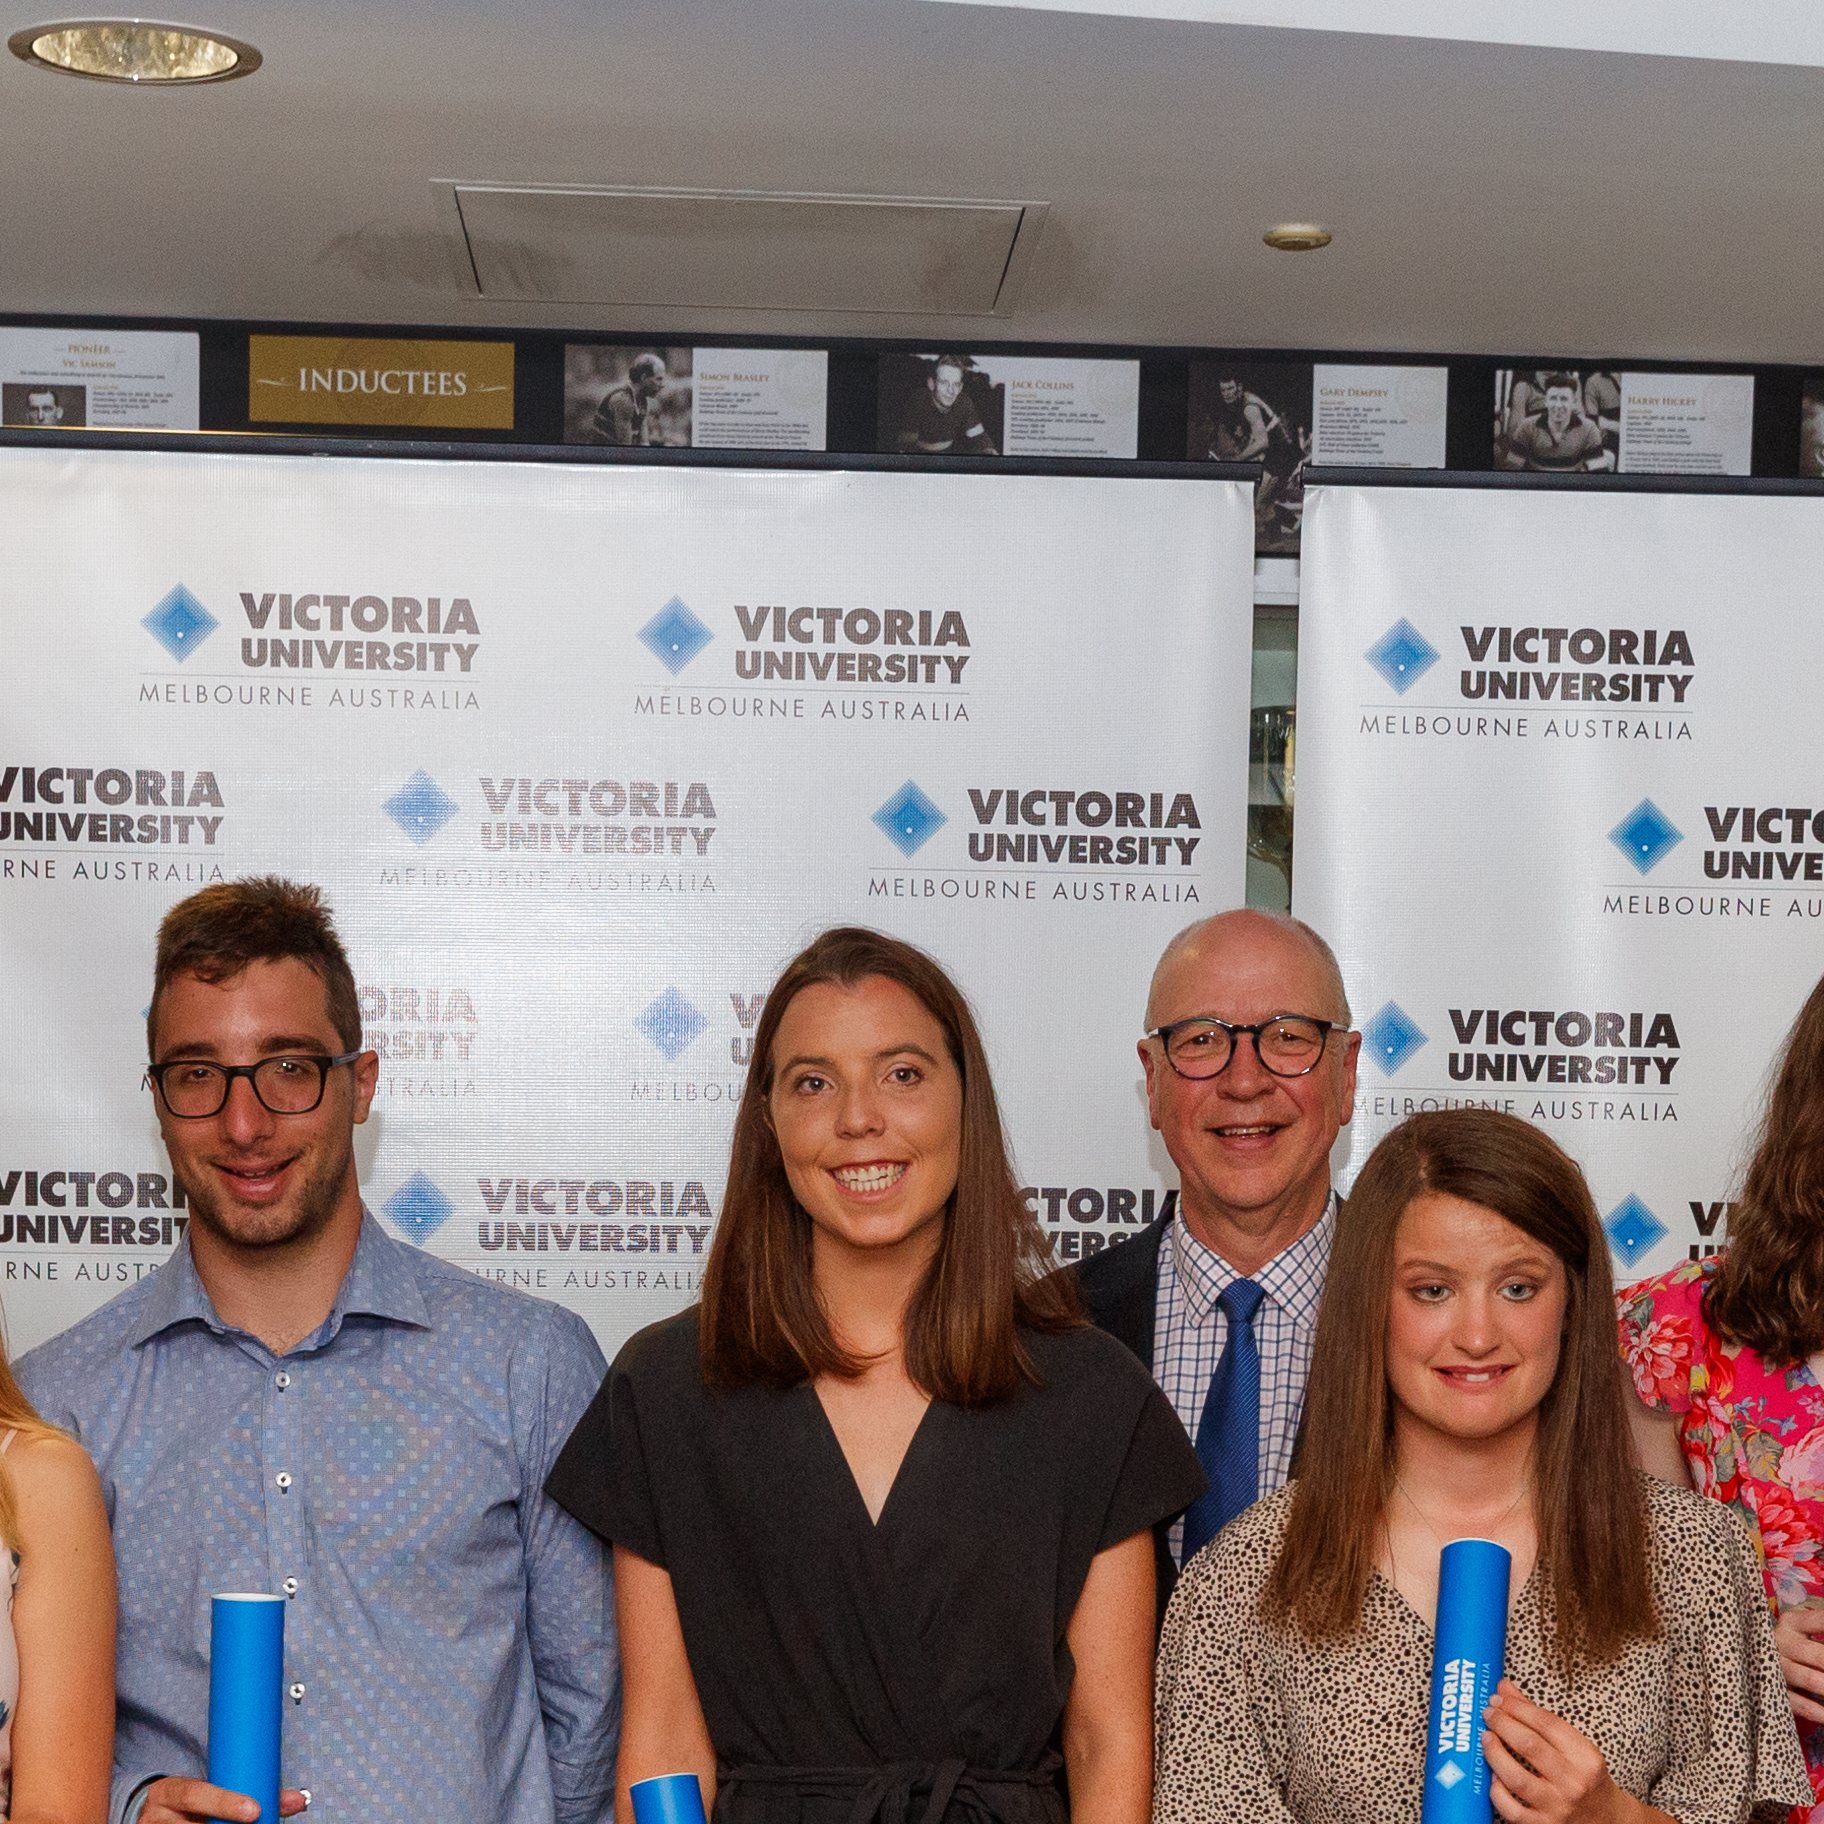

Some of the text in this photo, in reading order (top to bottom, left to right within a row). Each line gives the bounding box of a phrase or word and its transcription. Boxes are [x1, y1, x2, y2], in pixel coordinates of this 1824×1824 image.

[298, 367, 467, 396] INDUCTEES
[1012, 381, 1034, 390] JACK
[240, 592, 480, 635] VICTORIA
[735, 605, 971, 647] VICTORIA
[241, 638, 479, 673] UNIVERSITY
[1460, 626, 1695, 666] VICTORIA
[735, 651, 970, 684] UNIVERSITY
[139, 683, 481, 710] MELBOURNE AUSTRALIA
[1460, 672, 1694, 703] UNIVERSITY
[635, 694, 970, 722] MELBOURNE AUSTRALIA
[1360, 714, 1694, 740] MELBOURNE AUSTRALIA
[479, 777, 718, 820] VICTORIA
[967, 788, 1202, 829] VICTORIA
[480, 822, 717, 857] UNIVERSITY
[969, 834, 1201, 866] UNIVERSITY
[73, 860, 225, 883] AUSTRALIA
[380, 867, 717, 893] MELBOURNE AUSTRALIA
[868, 878, 1200, 904] MELBOURNE AUSTRALIA
[1603, 895, 1772, 918] MELBOURNE
[1448, 1010, 1680, 1050] VICTORIA
[1448, 1054, 1680, 1086] UNIVERSITY
[1531, 1099, 1679, 1122] AUSTRALIA
[477, 1178, 712, 1217] VICTORIA
[478, 1222, 712, 1254] UNIVERSITY
[1438, 1658, 1462, 1755] VICTORIA
[1455, 1659, 1477, 1753] UNIVERSITY
